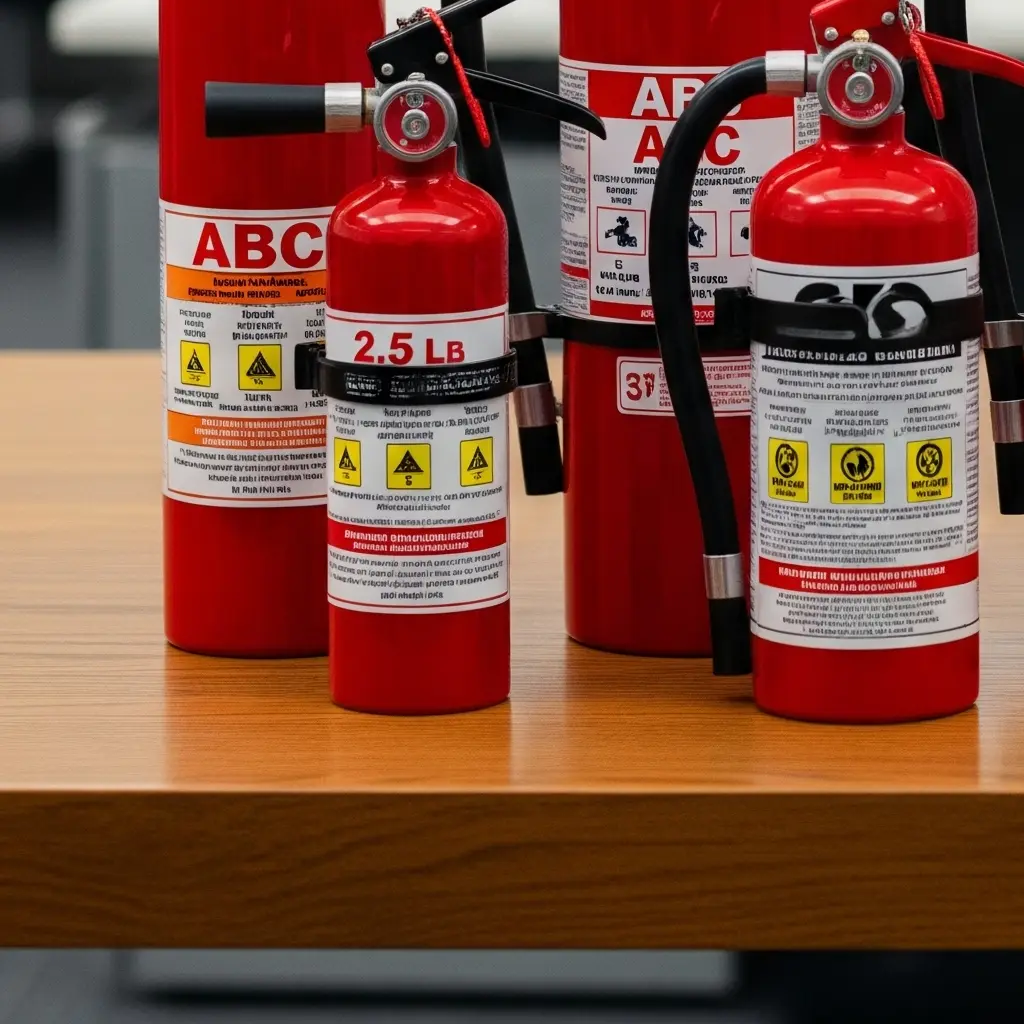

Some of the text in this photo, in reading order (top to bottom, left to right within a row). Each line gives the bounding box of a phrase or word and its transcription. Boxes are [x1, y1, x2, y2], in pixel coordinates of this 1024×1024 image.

[633, 125, 741, 166] AC
[192, 222, 324, 269] ABC
[353, 330, 465, 366] 2.5 LB
